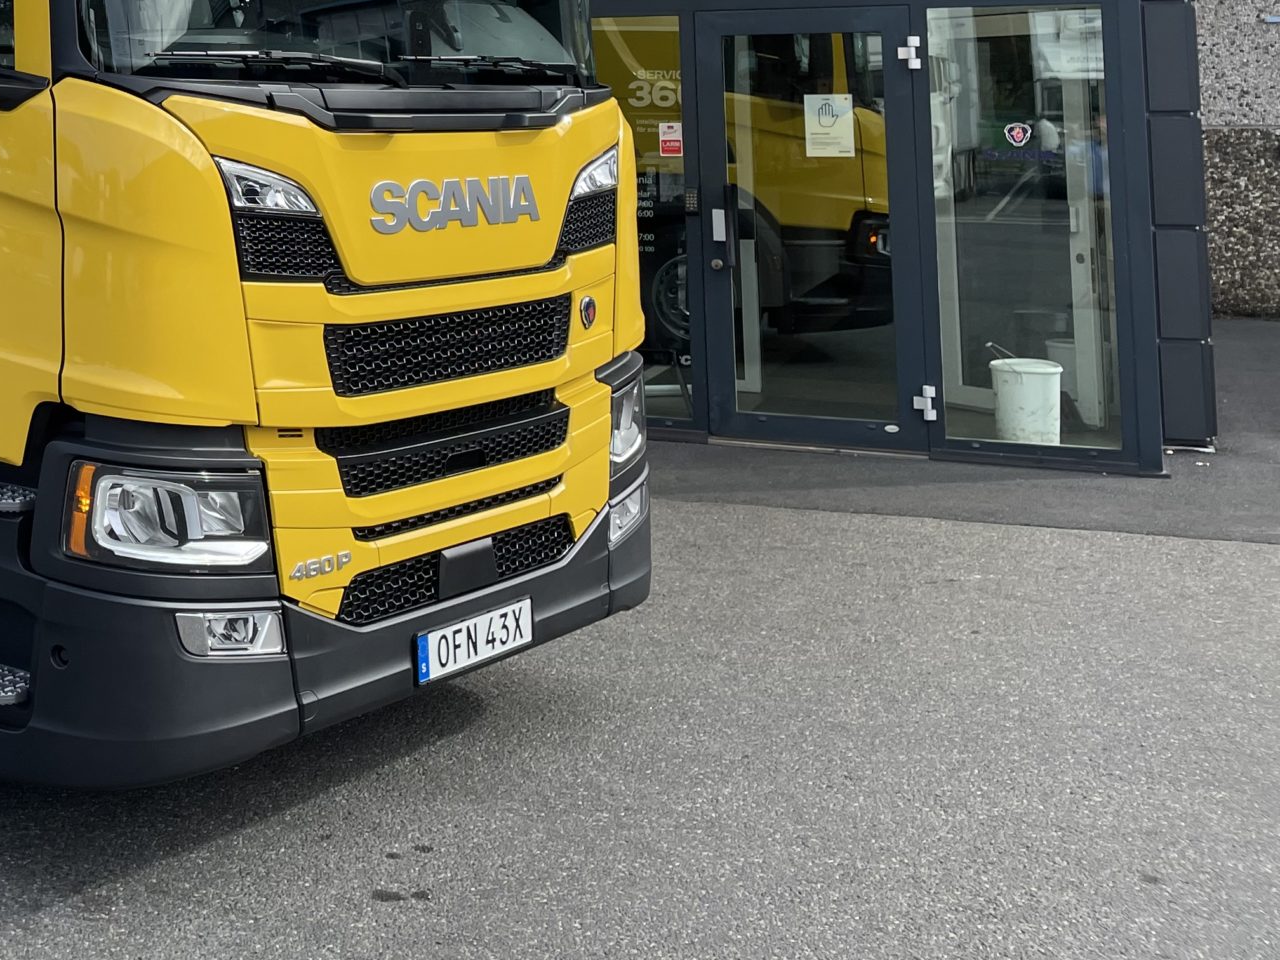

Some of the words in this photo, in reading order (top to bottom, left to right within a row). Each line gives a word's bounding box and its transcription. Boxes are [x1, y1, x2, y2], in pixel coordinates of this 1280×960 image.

[370, 174, 540, 235] SCANIA
[289, 557, 335, 582] 460
[437, 622, 479, 669] OFN
[485, 605, 525, 651] 43X
[421, 663, 427, 673] S
